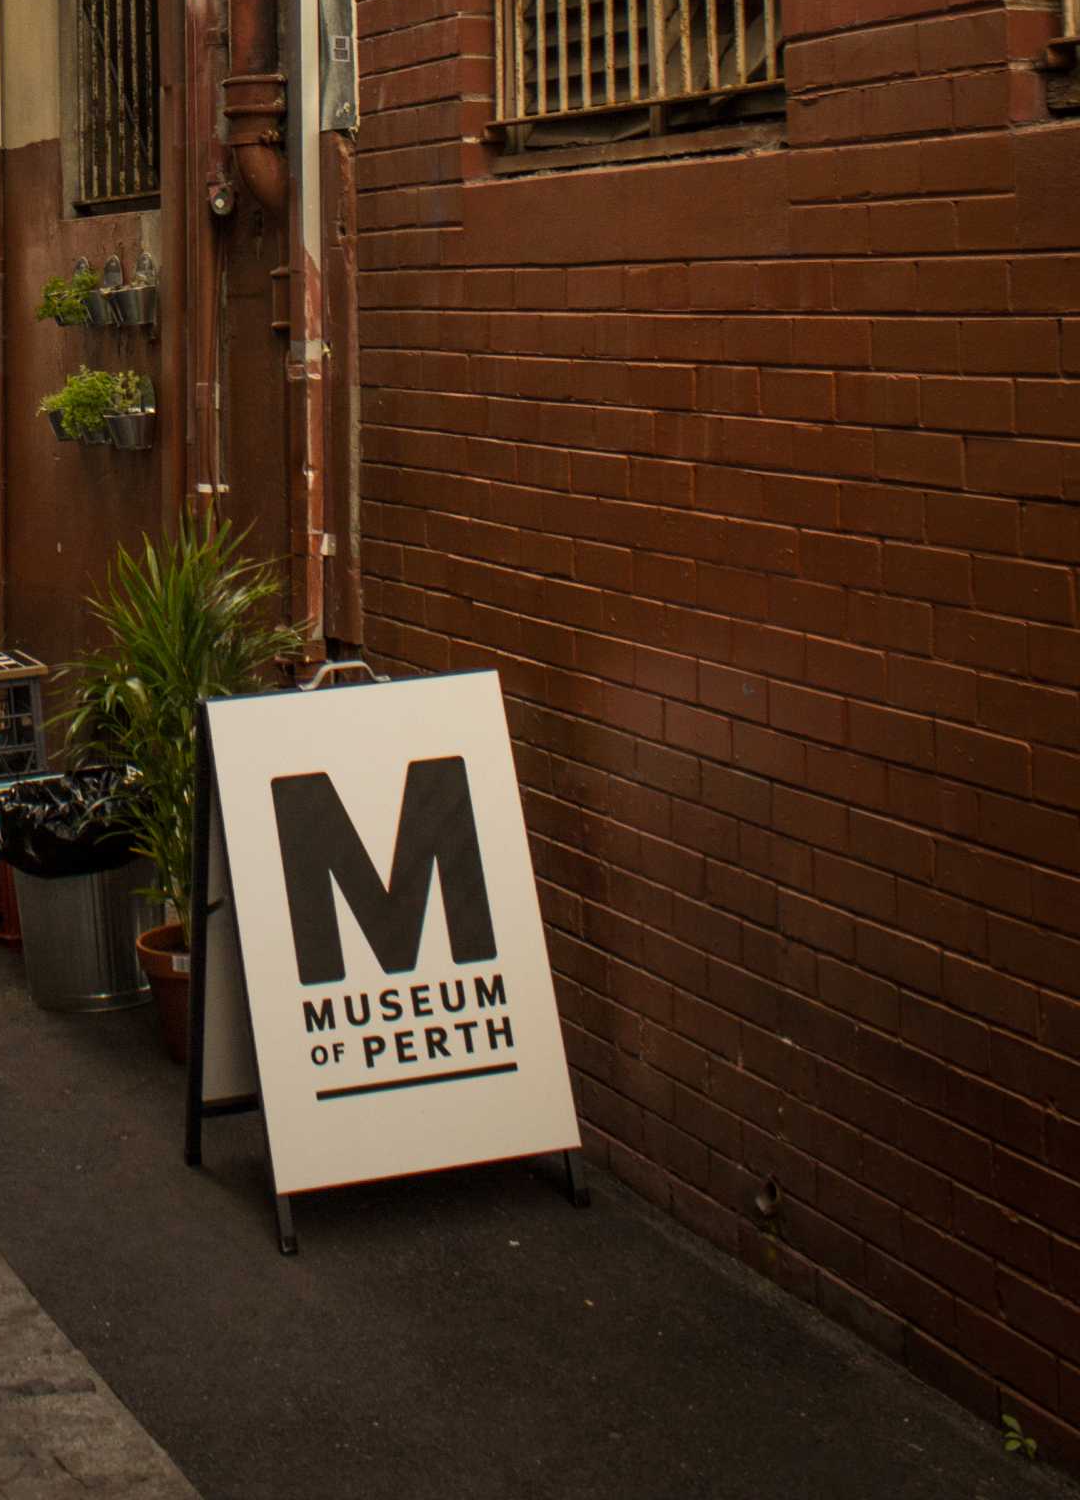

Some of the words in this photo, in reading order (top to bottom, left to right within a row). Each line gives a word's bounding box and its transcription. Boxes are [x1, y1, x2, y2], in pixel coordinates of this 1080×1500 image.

[270, 755, 498, 986] M
[302, 973, 508, 1033] MUSEUM
[310, 1042, 346, 1066] OF
[362, 1016, 515, 1069] PERTH
